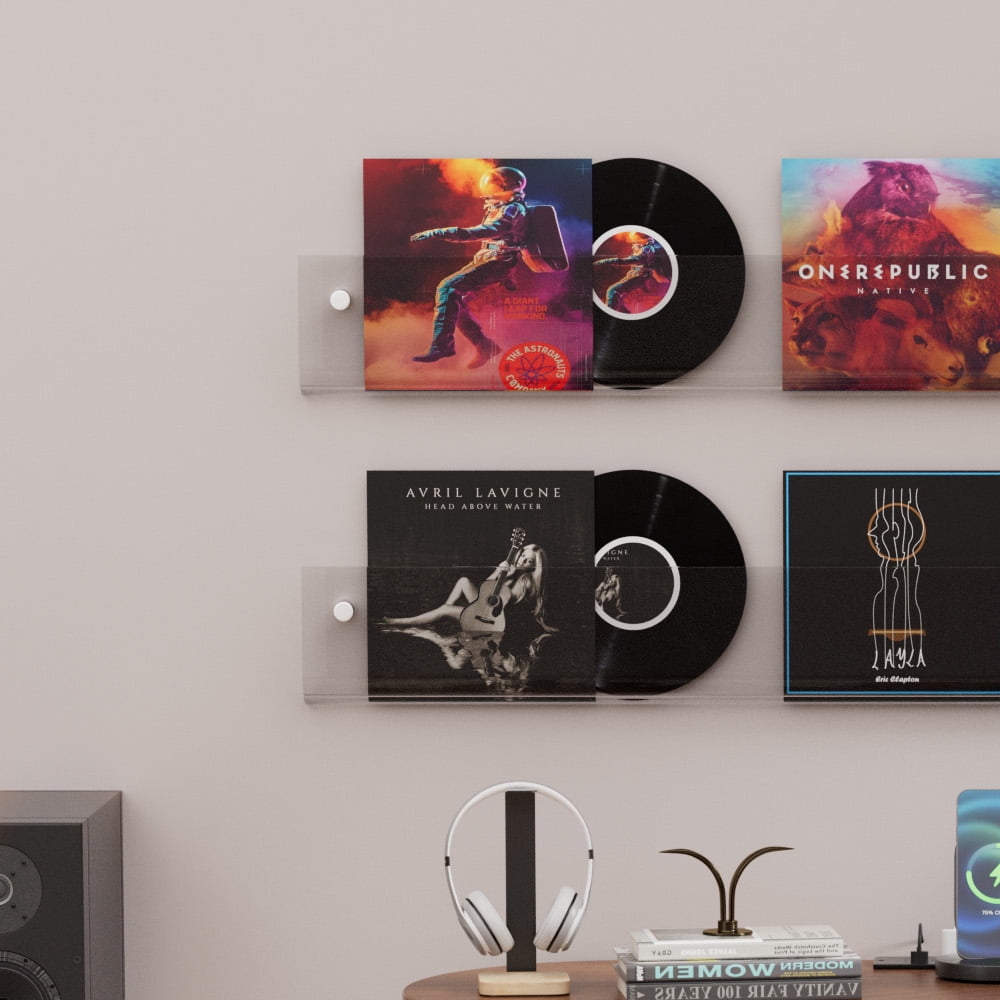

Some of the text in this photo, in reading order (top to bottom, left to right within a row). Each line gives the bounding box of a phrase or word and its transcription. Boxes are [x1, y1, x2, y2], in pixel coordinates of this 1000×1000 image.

[798, 264, 989, 280] ONEREPUBLIC
[506, 345, 566, 379] THE ASTRONAUTS
[405, 488, 561, 498] AVRIL LAVIGNE
[890, 676, 920, 684] Clapton
